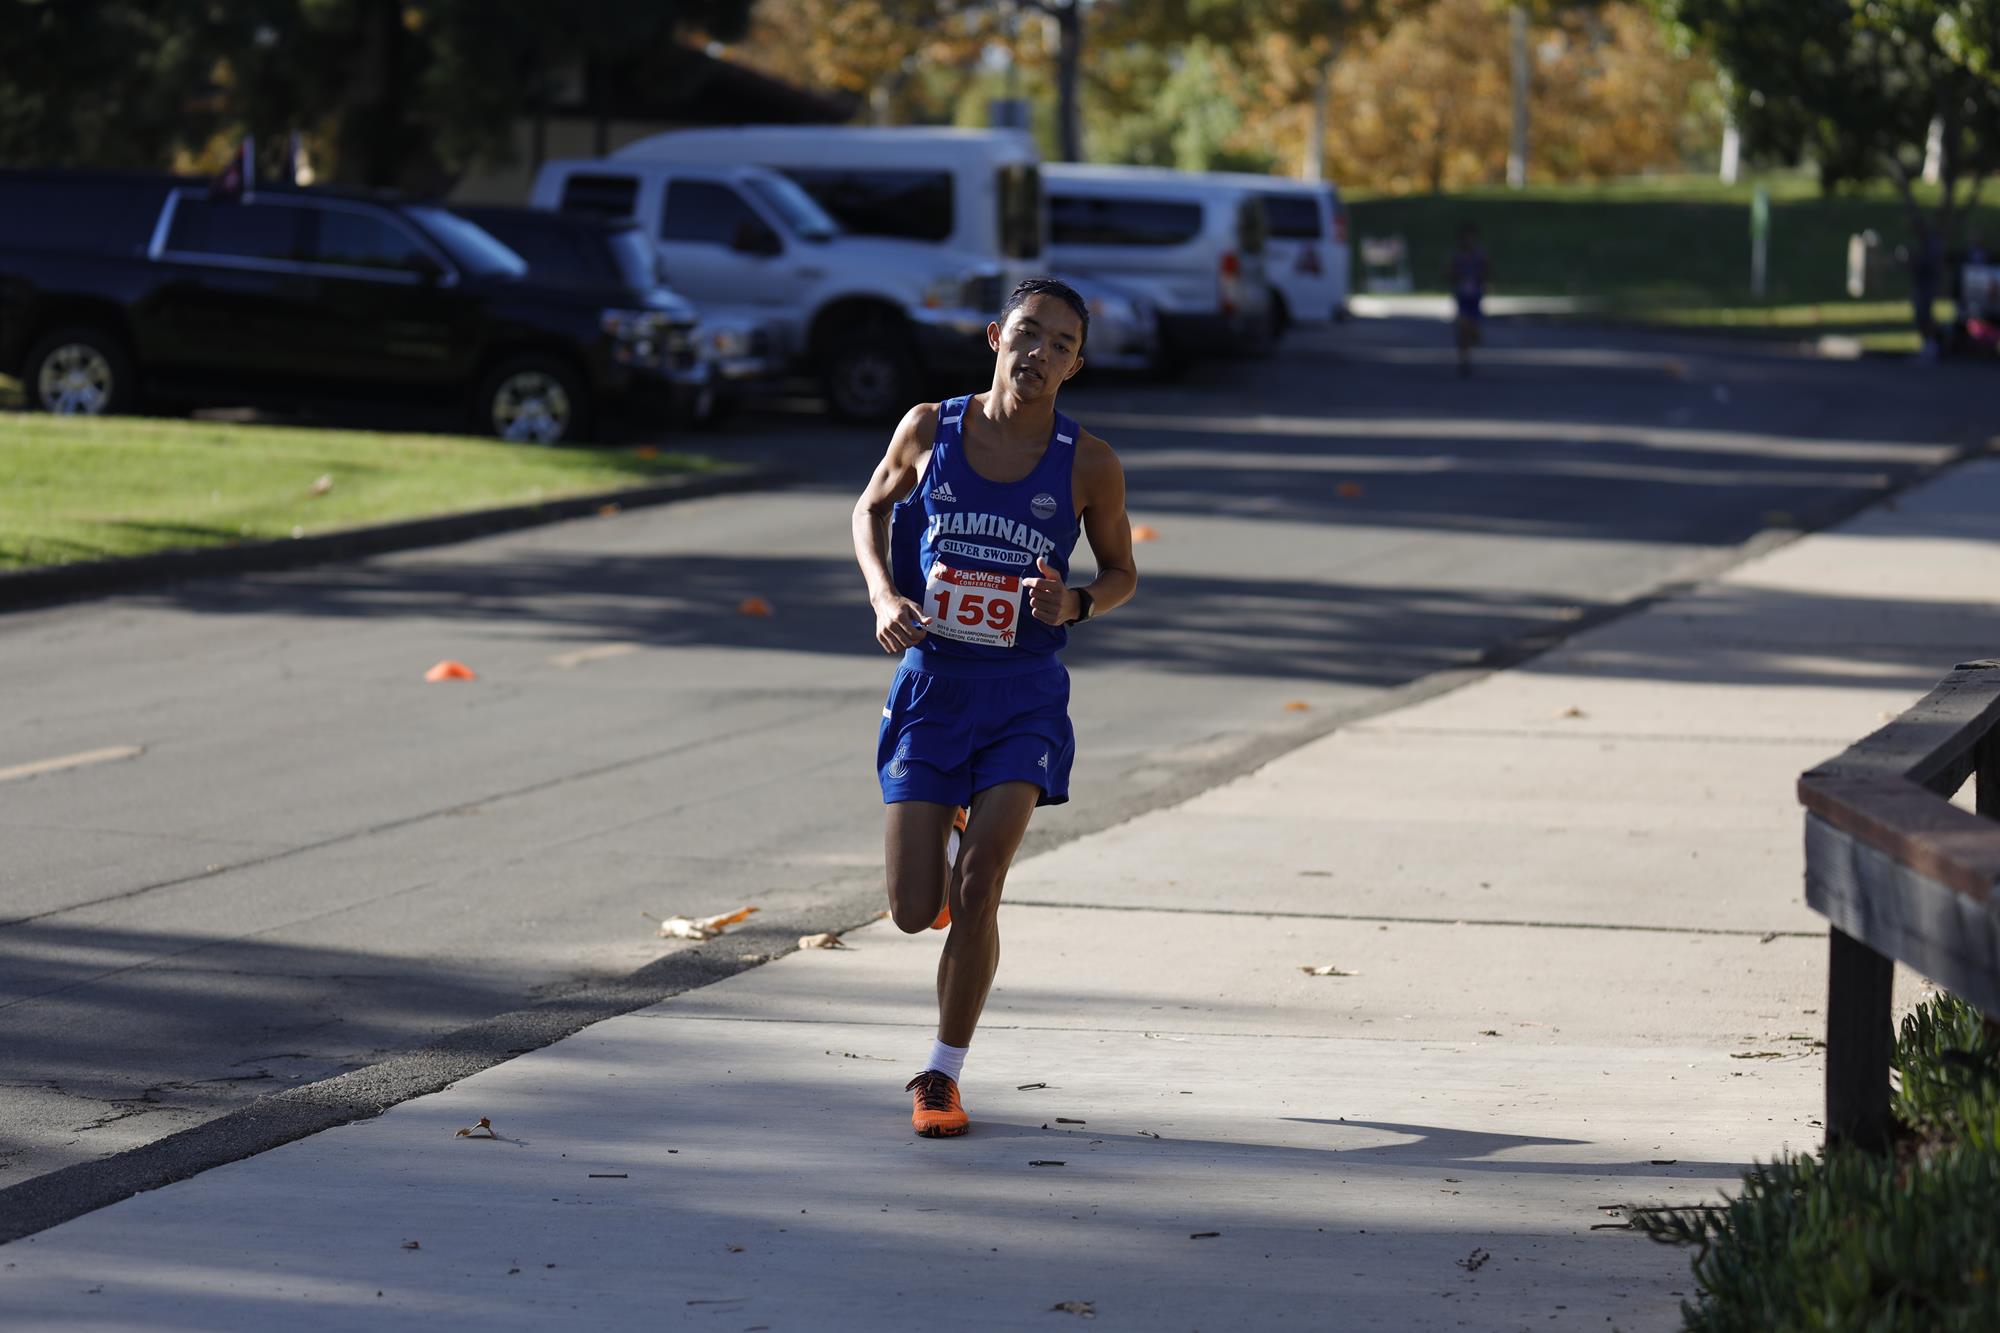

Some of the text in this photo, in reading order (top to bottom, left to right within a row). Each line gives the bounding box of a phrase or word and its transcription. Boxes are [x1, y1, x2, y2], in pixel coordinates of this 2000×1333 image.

[930, 492, 957, 503] adidas
[928, 512, 1055, 565] CHAMINADE
[943, 540, 1028, 565] SILVER SWORDS
[954, 570, 1007, 585] PacWest
[959, 580, 1000, 589] CONFERENCE
[934, 590, 1015, 631] 159
